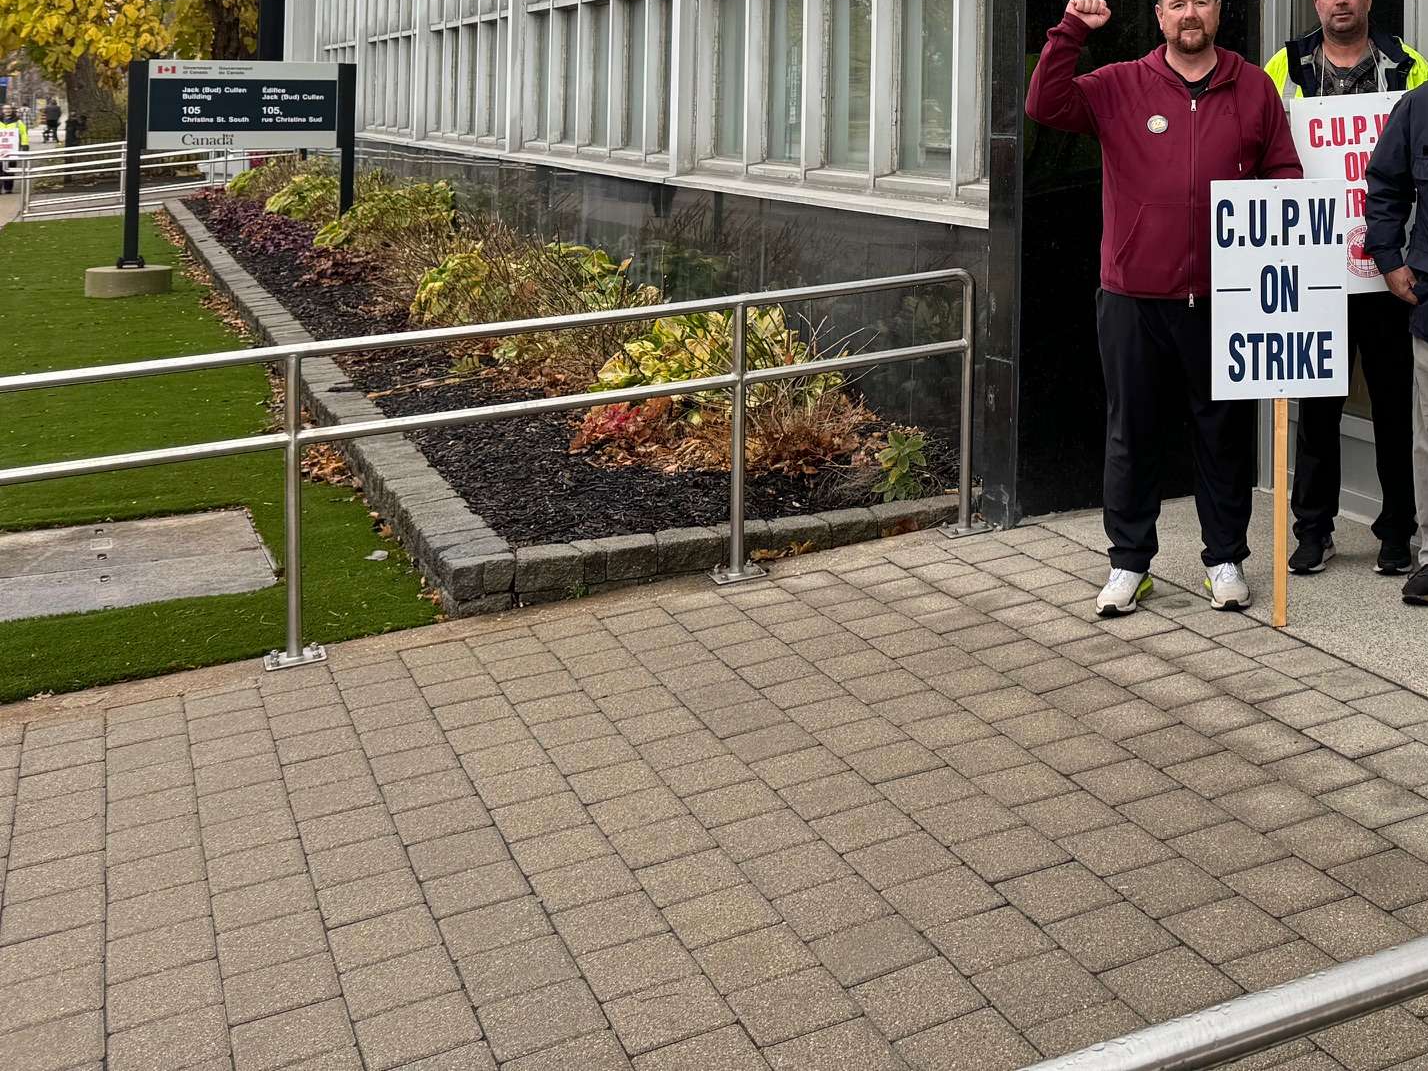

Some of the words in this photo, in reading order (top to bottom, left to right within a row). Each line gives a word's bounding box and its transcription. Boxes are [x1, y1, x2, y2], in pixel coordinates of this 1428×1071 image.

[182, 93, 212, 101] Building
[182, 106, 202, 115] 105
[262, 106, 283, 116] 105,
[181, 133, 234, 146] Canada
[1216, 198, 1344, 248] C.U.P.W.
[1260, 264, 1299, 314] ON
[1228, 331, 1334, 382] STRIKE
